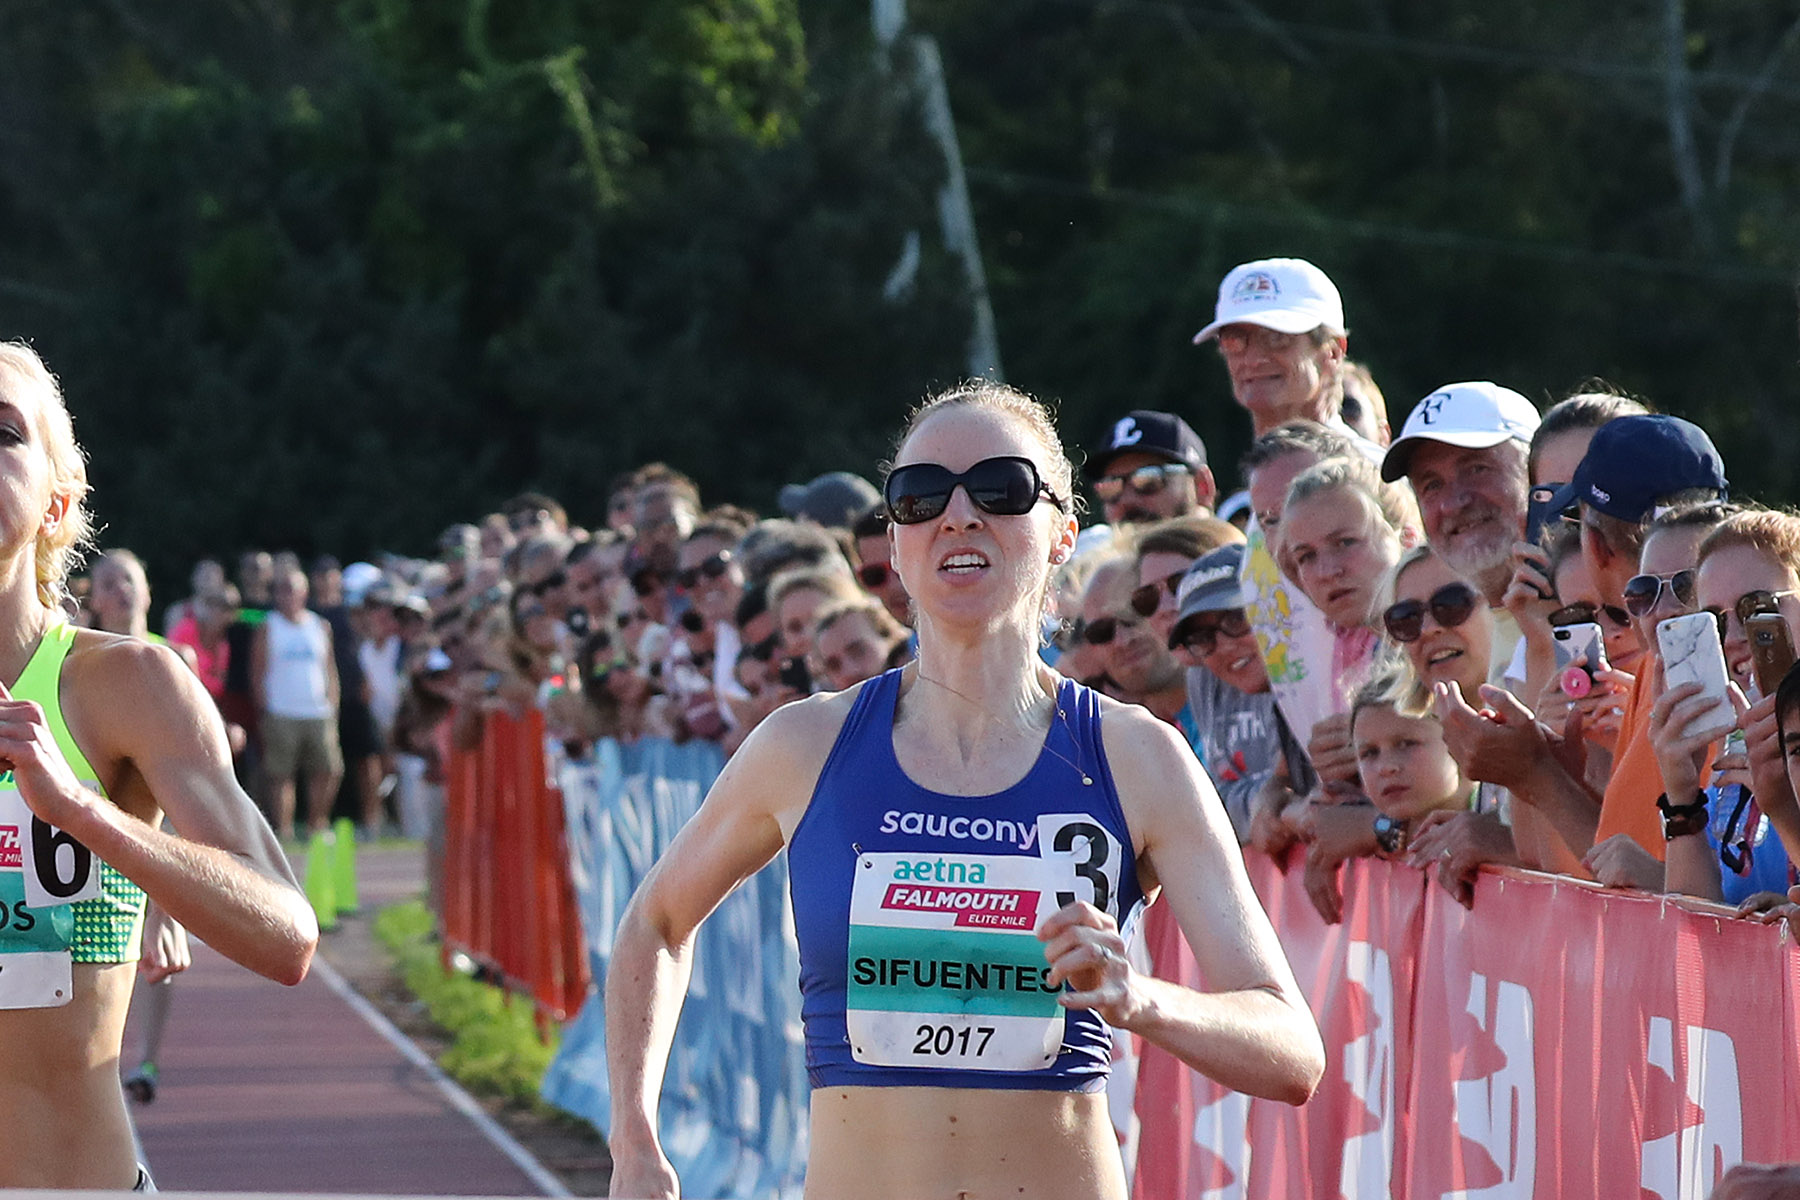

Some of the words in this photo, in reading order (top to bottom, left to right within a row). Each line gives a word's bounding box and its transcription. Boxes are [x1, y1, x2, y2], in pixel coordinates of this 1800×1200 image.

[879, 809, 1038, 850] saucony
[5, 853, 22, 863] MIL
[31, 811, 92, 898] 6
[893, 857, 986, 884] aetna
[1053, 821, 1110, 912] 3
[890, 889, 1019, 912] FALMOUTH
[968, 914, 999, 925] ELITE
[1000, 915, 1027, 926] MILE
[853, 957, 1062, 993] SIFUENTES
[912, 1025, 995, 1057] 2017
